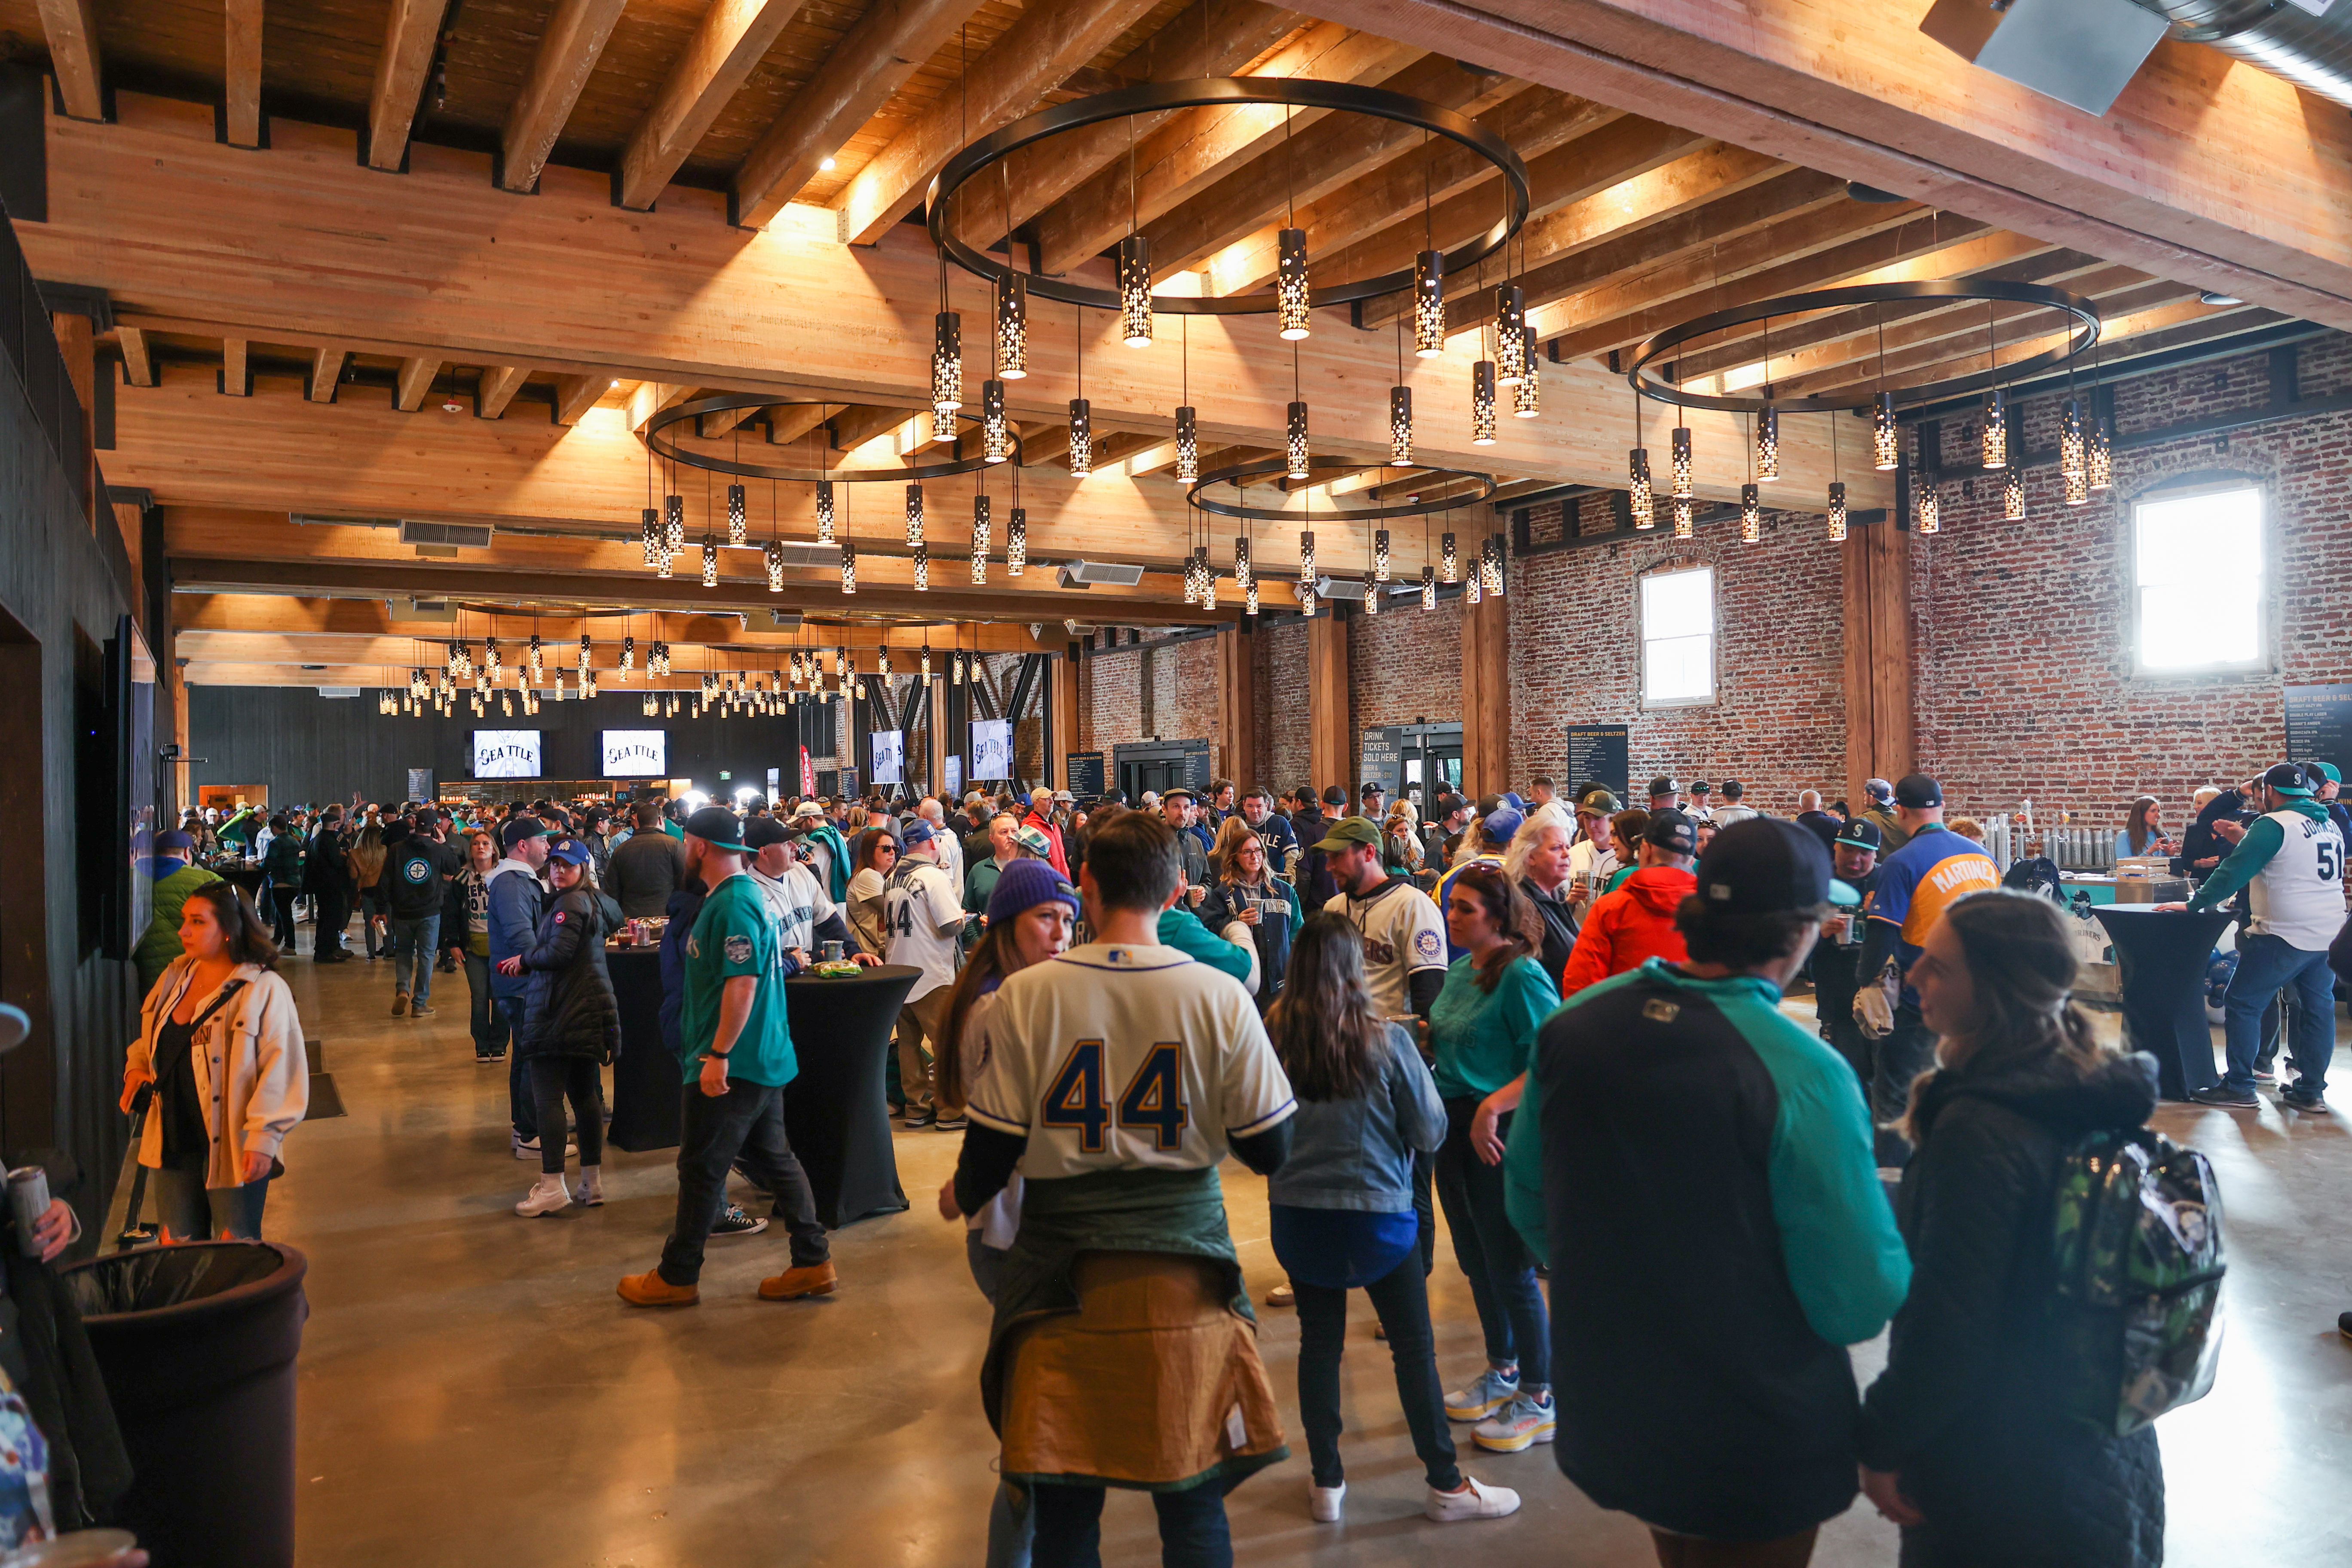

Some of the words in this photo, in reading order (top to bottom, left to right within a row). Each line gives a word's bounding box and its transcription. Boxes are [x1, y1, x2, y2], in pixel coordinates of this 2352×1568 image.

[1364, 732, 1384, 741] DRINK
[1364, 742, 1389, 751] TICKETS
[481, 745, 533, 766] SEATTLE
[609, 745, 658, 764] SEATTLE
[1363, 753, 1379, 762] SOLD
[1381, 753, 1398, 762] HERE
[1853, 824, 1864, 837] S
[2317, 842, 2343, 880] 51
[1931, 860, 1996, 893] MARTINEZ
[886, 899, 913, 938] 44
[1041, 1038, 1188, 1153] 44
